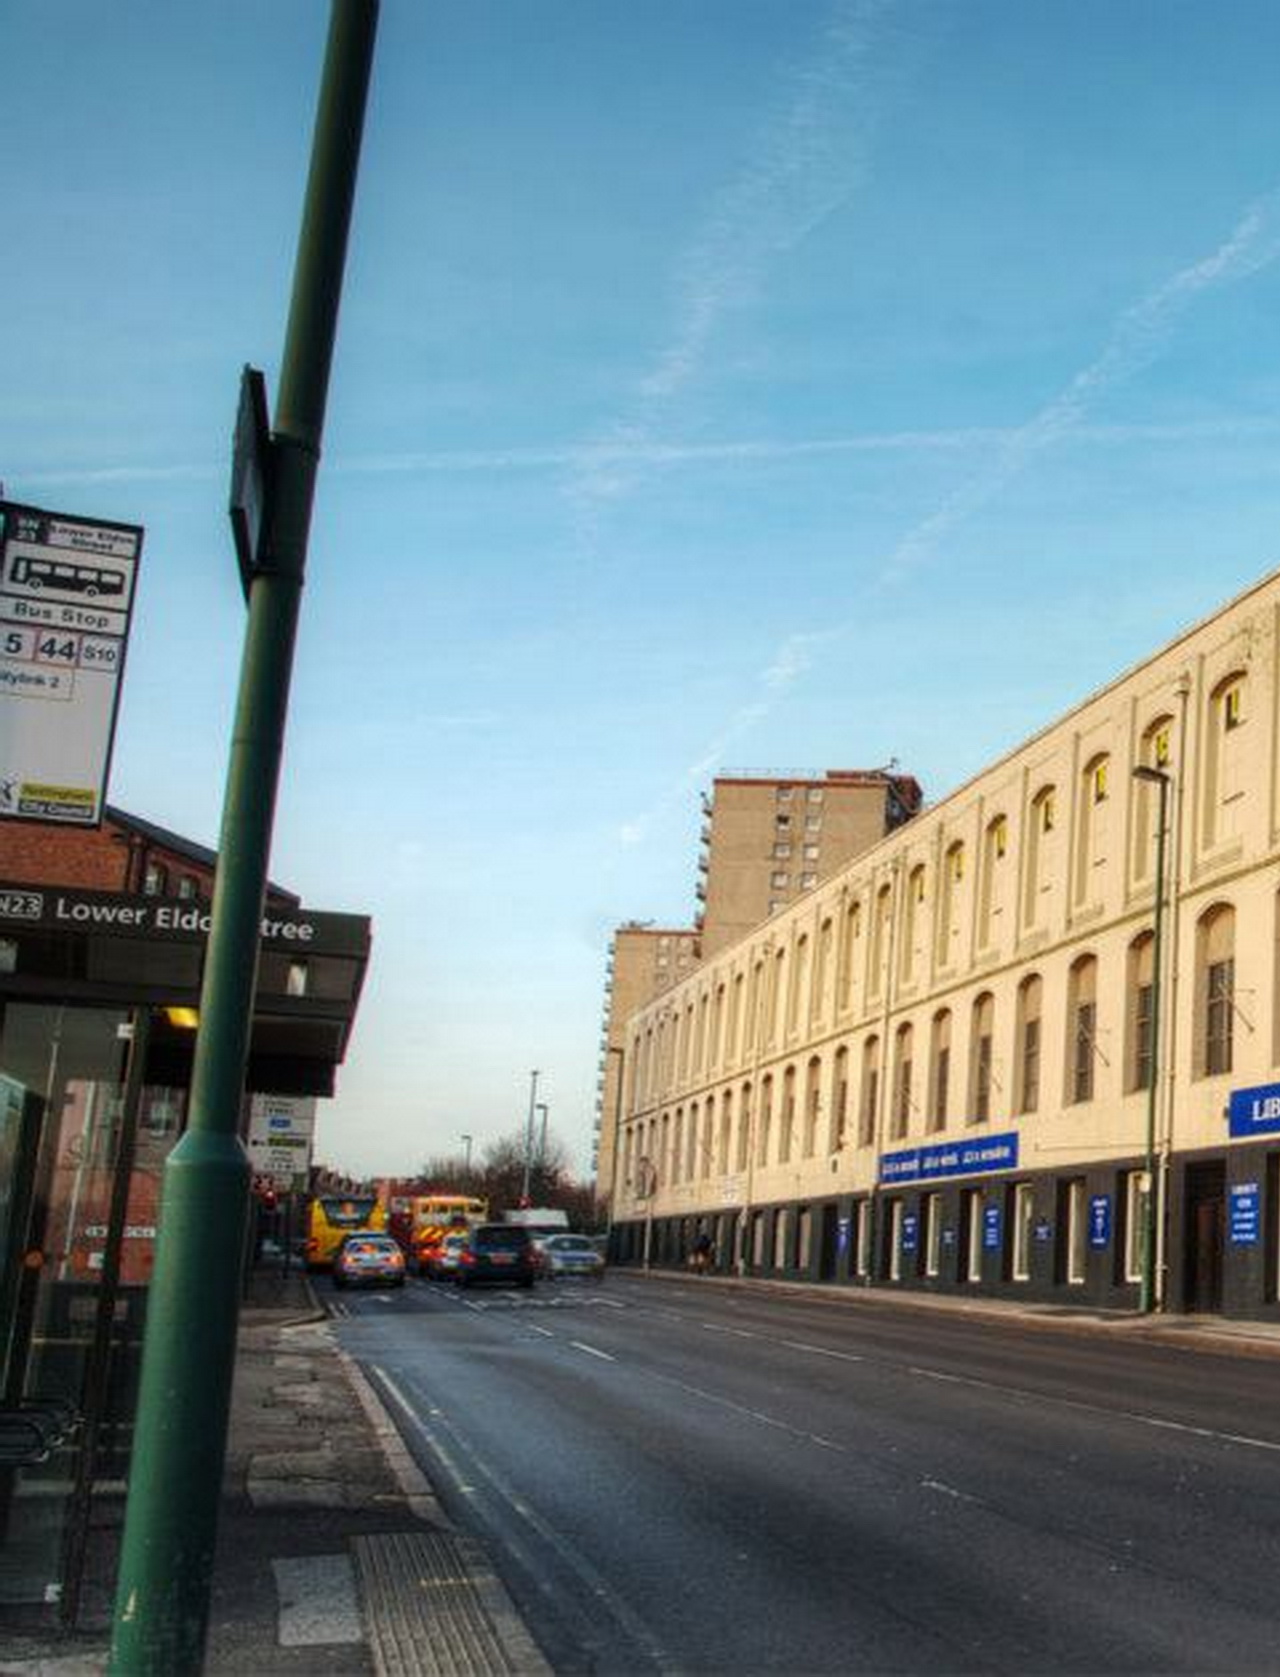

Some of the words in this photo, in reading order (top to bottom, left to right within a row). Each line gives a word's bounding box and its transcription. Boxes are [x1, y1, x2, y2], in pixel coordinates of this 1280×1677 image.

[15, 602, 52, 619] Bus
[61, 608, 109, 628] Stop
[4, 633, 22, 654] 5
[40, 637, 75, 660] 44
[84, 645, 116, 662] S10
[56, 898, 146, 925] Lower
[156, 908, 215, 932] Eldo
